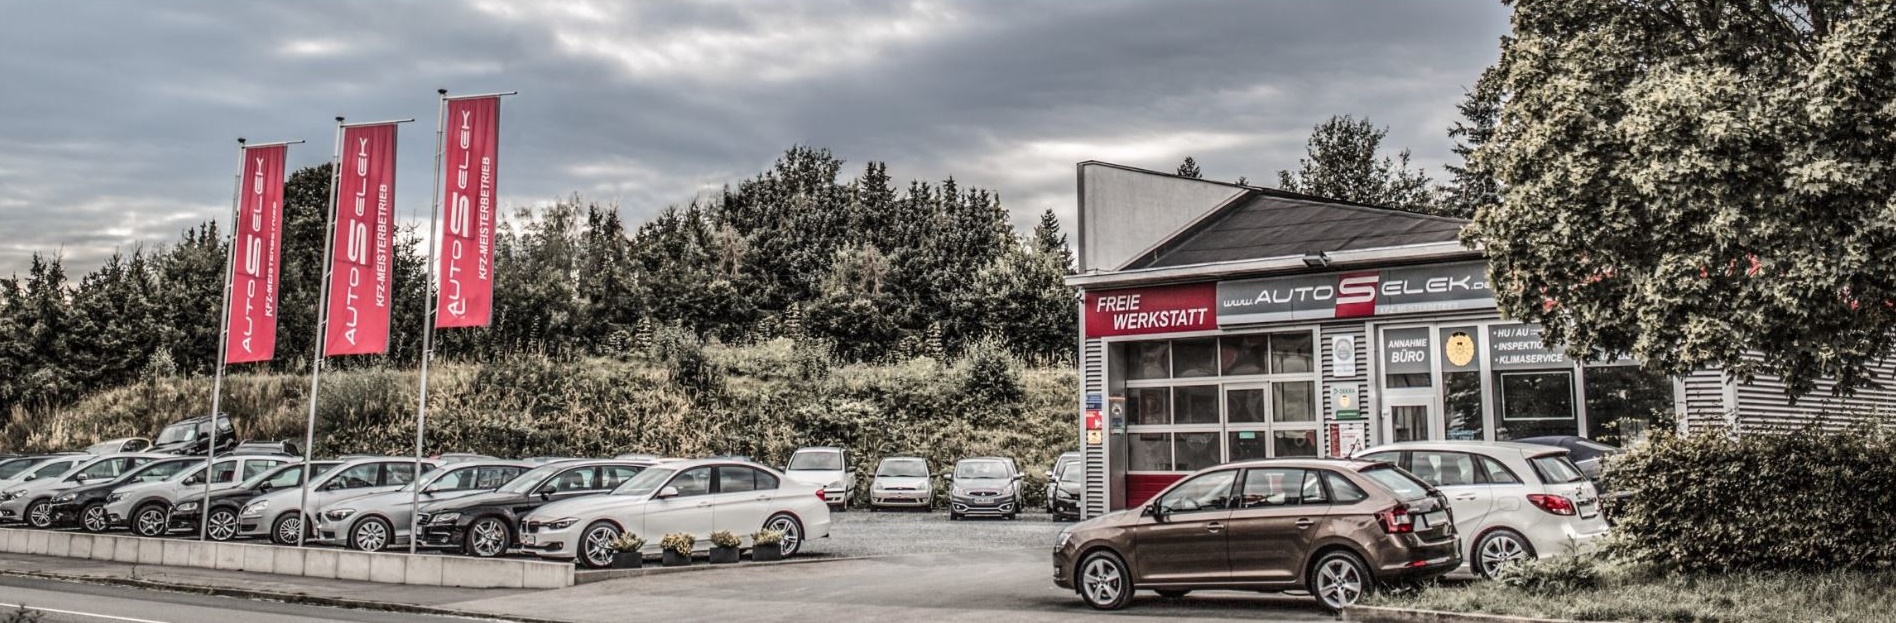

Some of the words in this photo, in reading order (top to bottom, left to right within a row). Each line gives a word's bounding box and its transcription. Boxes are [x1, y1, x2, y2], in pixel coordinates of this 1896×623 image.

[478, 156, 490, 280] KFZ-MEISTERBETRIEB
[376, 184, 388, 307] KFZ-MEISTERBETRIEB
[1096, 294, 1141, 313] FREIE
[1113, 308, 1208, 330] WERKSTATT
[1388, 338, 1428, 348] ANNAHME
[1499, 340, 1545, 351] INSPEKTIO
[1391, 349, 1425, 363] BÜRO
[1499, 353, 1563, 364] KLIMASERVICE
